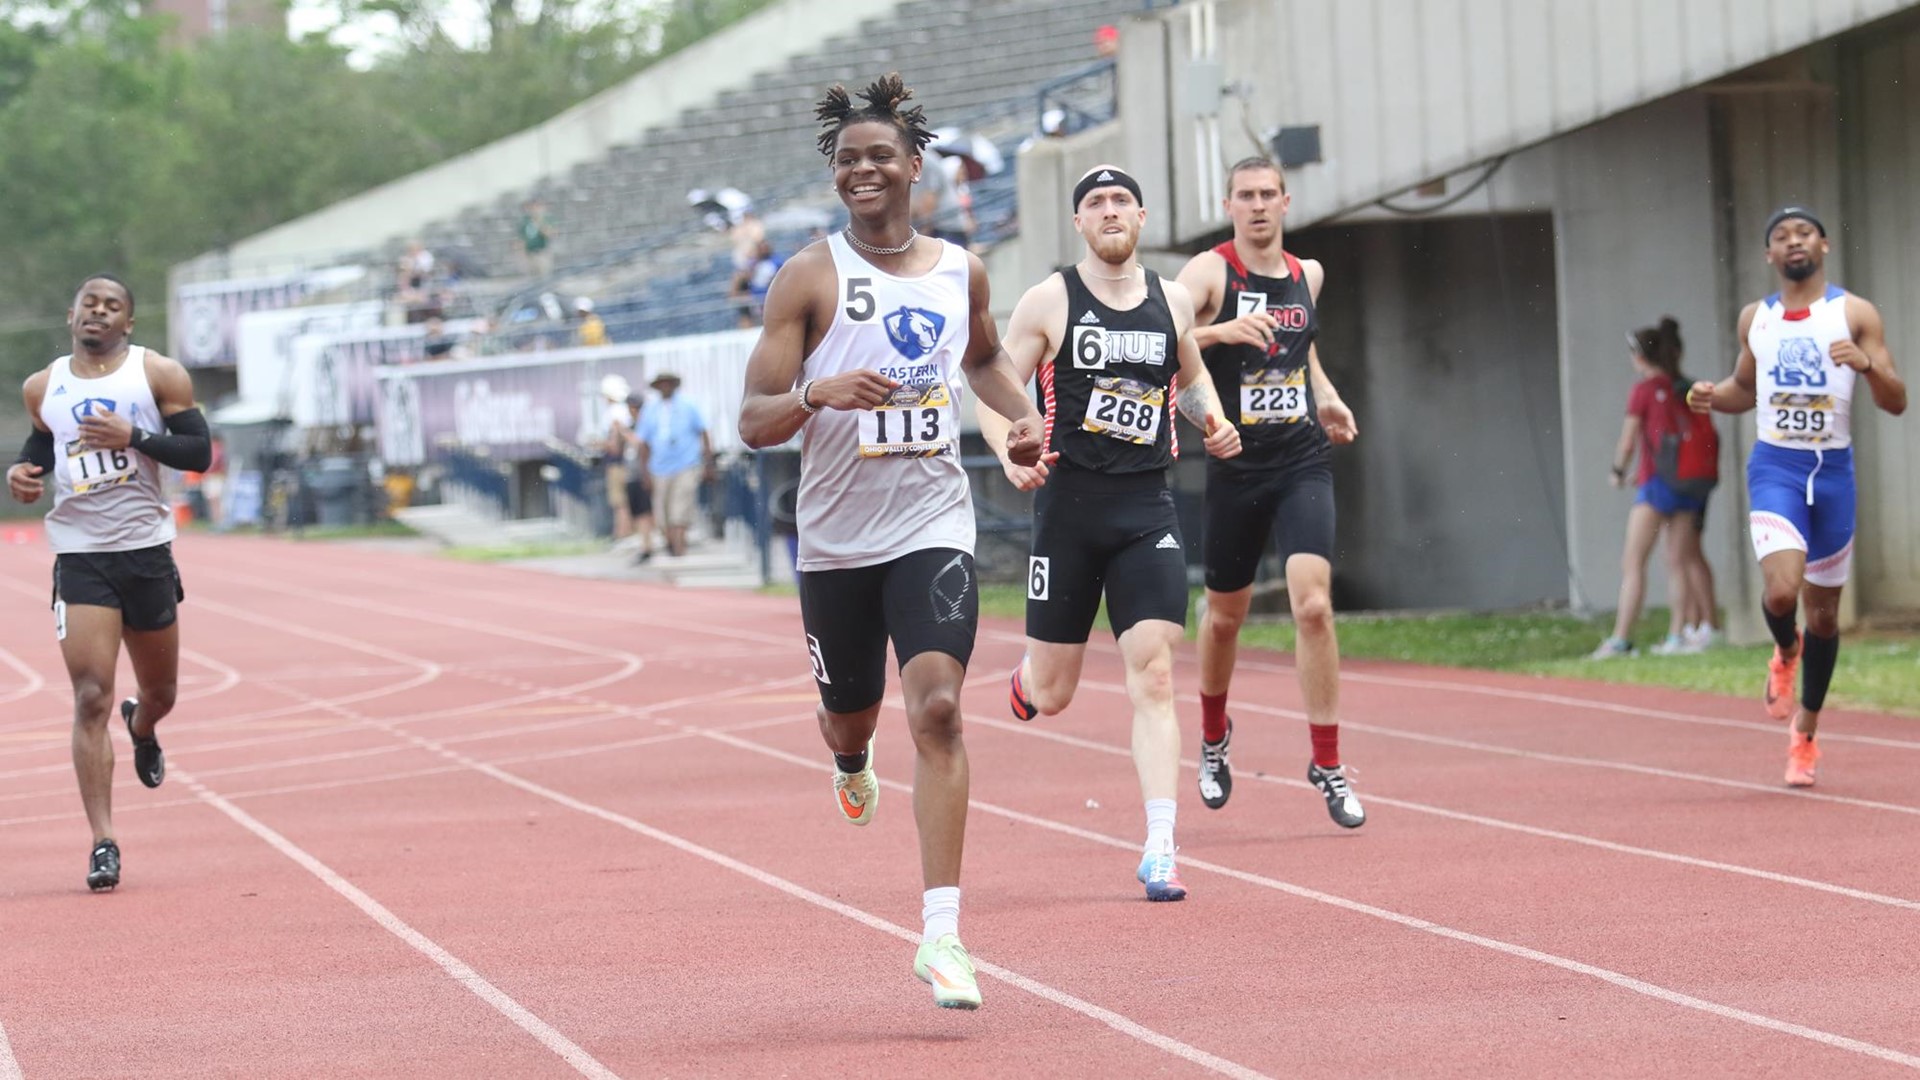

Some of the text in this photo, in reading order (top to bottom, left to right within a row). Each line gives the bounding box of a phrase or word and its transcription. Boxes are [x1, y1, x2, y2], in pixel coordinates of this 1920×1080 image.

[845, 277, 876, 322] 5
[1241, 295, 1261, 313] 7
[1077, 329, 1102, 367] 6
[879, 364, 939, 379] EASTERN
[1095, 395, 1154, 432] 268
[1250, 387, 1298, 411] 223
[876, 408, 940, 444] 113
[1776, 409, 1825, 432] 299
[79, 449, 129, 479] 116
[1031, 559, 1046, 597] 6
[807, 635, 824, 678] 5
